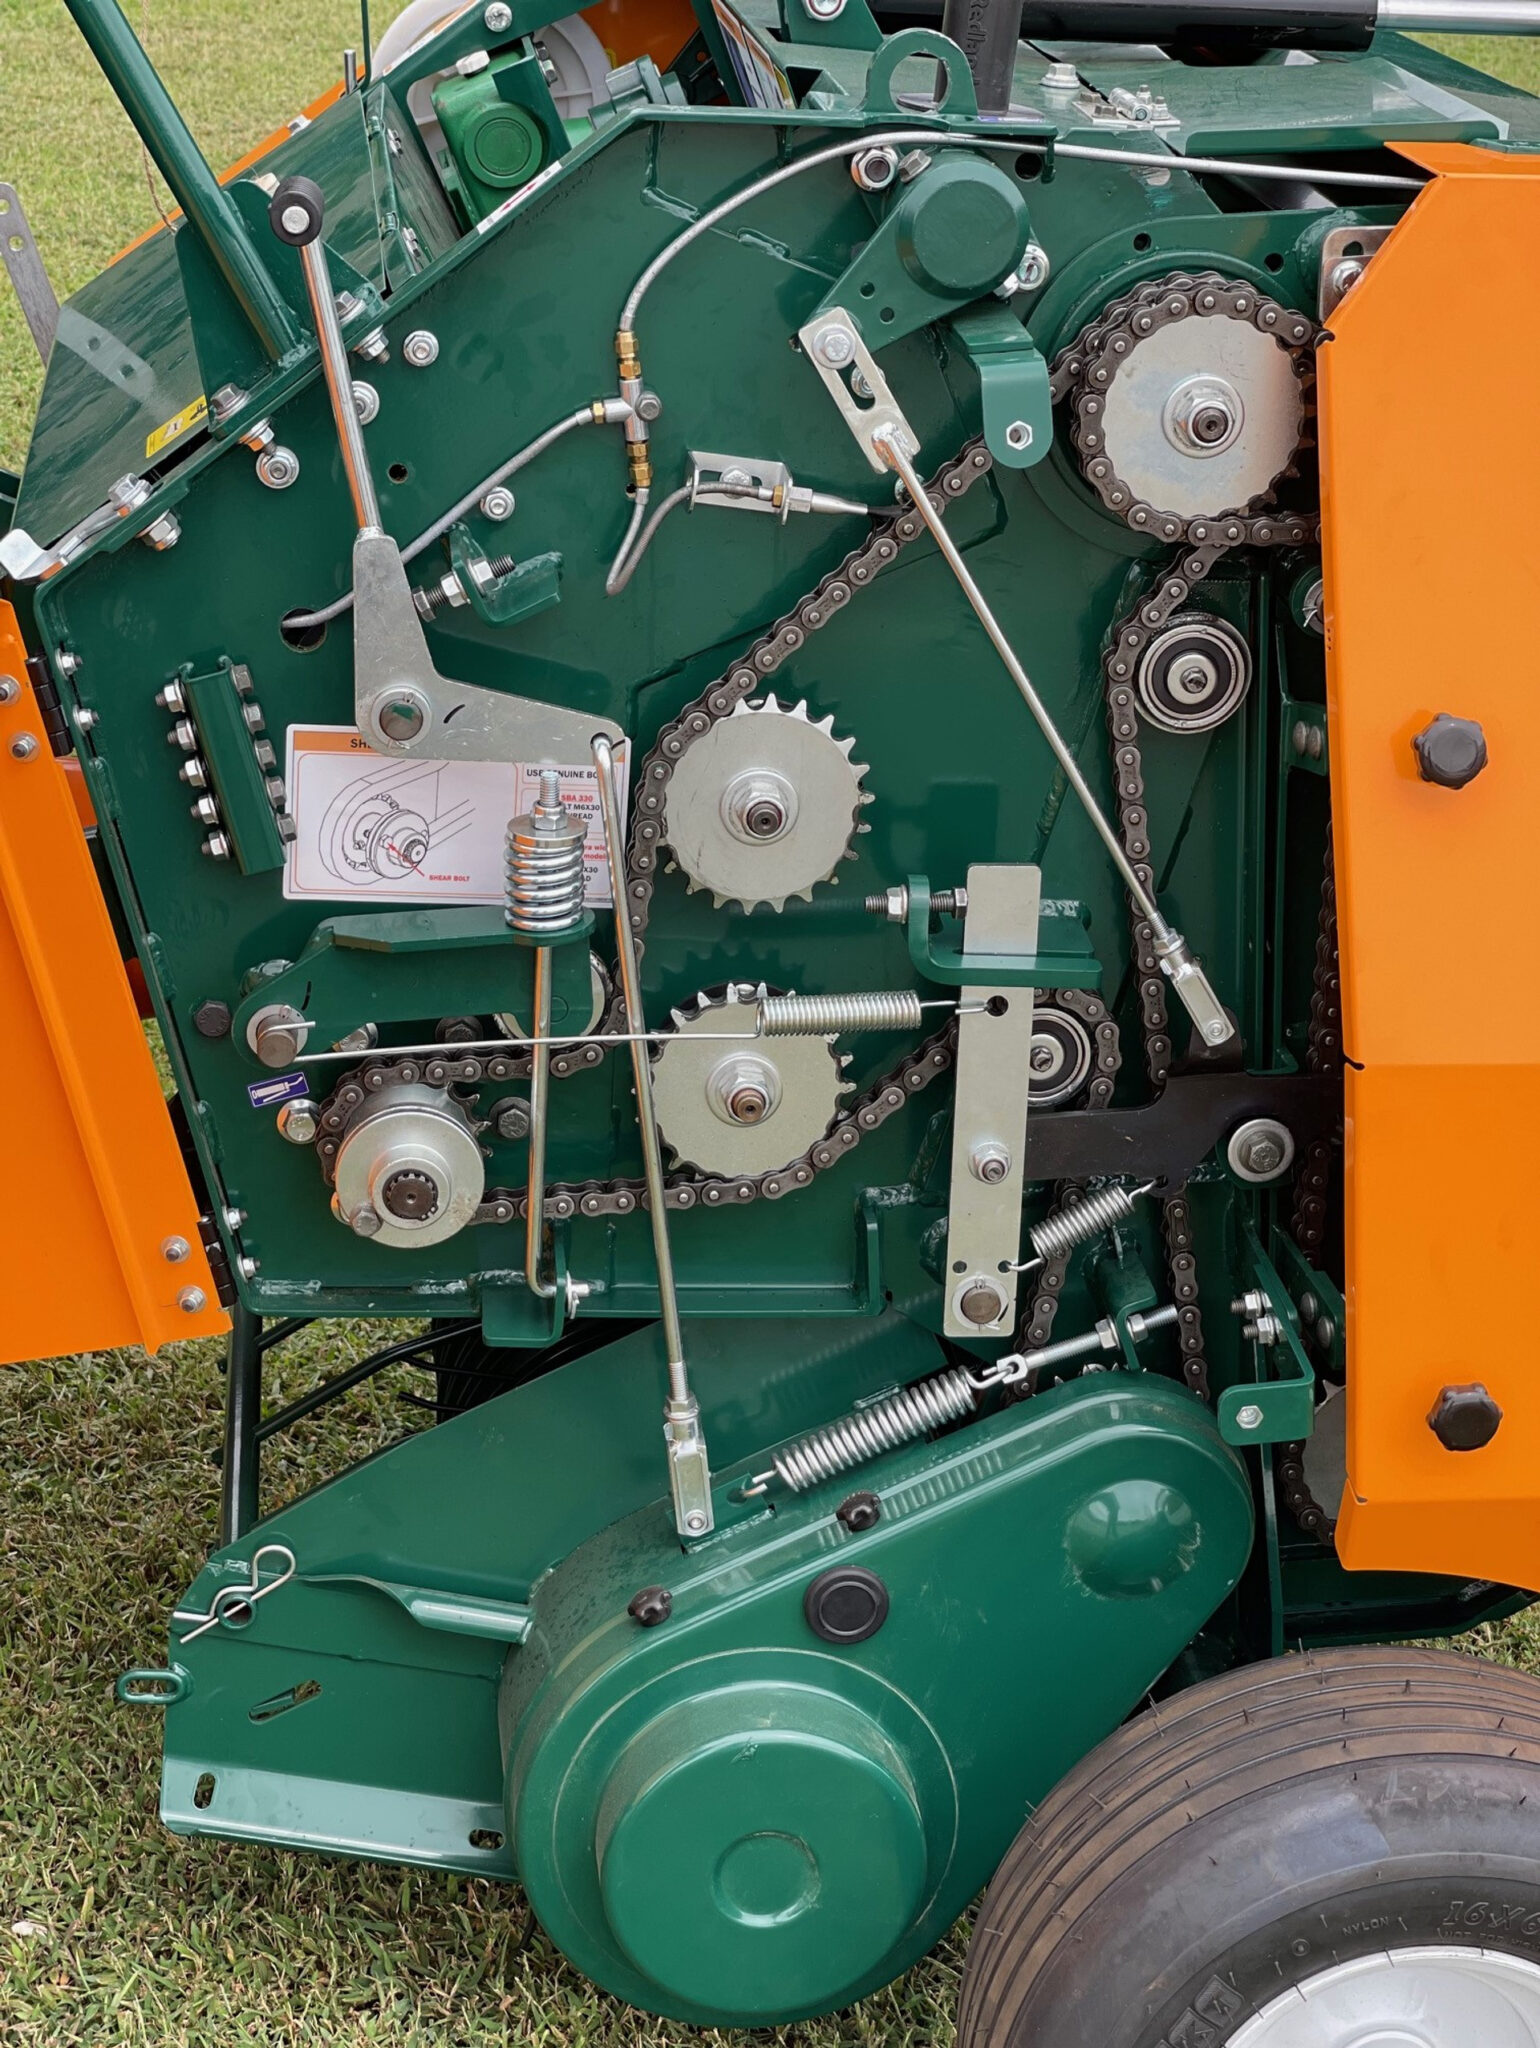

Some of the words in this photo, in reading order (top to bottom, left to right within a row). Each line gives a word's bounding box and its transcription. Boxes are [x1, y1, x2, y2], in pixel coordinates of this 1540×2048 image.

[964, 0, 989, 87] Redlan
[546, 769, 585, 779] NUINE
[586, 771, 599, 779] BO
[561, 794, 577, 802] SBA
[583, 866, 598, 874] X30
[1342, 1916, 1389, 1936] NYLON
